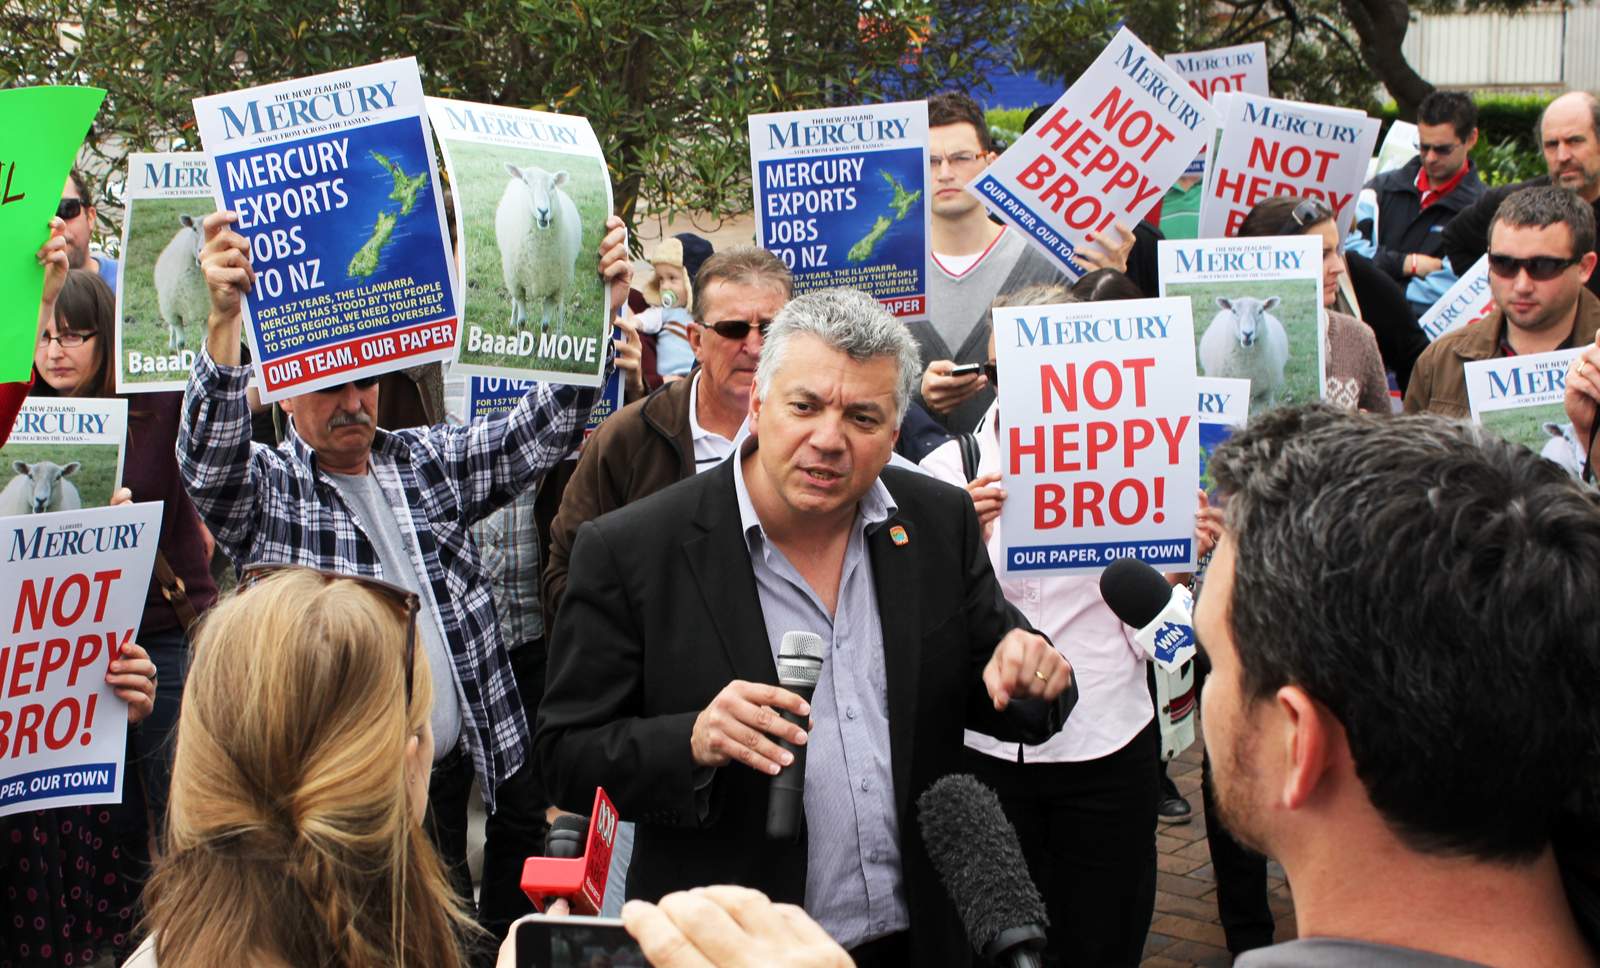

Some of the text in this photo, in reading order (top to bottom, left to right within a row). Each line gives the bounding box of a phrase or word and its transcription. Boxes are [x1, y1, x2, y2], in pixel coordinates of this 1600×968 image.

[1176, 52, 1256, 73] MERCURY
[275, 80, 352, 102] THE NEW ZEALAND
[1115, 44, 1205, 132] MERCURY
[217, 80, 398, 141] MERCURY
[444, 106, 580, 145] MERCURY
[843, 114, 874, 122] ZEALAND
[1090, 85, 1175, 163] NOT
[1242, 102, 1363, 144] MERCURY
[767, 117, 910, 150] MERCURY
[226, 138, 350, 192] MERCURY
[766, 157, 865, 189] MERCURY
[1035, 106, 1161, 214] HEPPY
[1247, 136, 1340, 183] NOT
[234, 178, 349, 229] EXPORTS
[768, 187, 857, 217] EXPORTS
[1015, 153, 1116, 243] BRO!
[768, 218, 819, 245] JOBS
[983, 180, 1084, 272] OUR PAPER, OUR TO
[802, 244, 829, 268] NZ
[805, 271, 833, 281] YEARS,
[834, 269, 850, 277] THE
[851, 264, 898, 276] ILLAWARRA
[1175, 248, 1305, 273] MERCURY
[254, 258, 325, 301] TO NZ
[811, 279, 829, 287] HAS
[830, 275, 857, 285] STOOD
[859, 274, 870, 282] BY
[871, 272, 886, 280] THE
[887, 268, 918, 279] PEOPLE
[875, 278, 897, 288] YOUR
[898, 276, 919, 285] HELP
[875, 284, 919, 296] OVERSEAS.
[257, 276, 415, 320] FOR 157 YEARS, THE ILLAWARRA
[260, 281, 442, 332] MERCURY HAS STOOD BY THE PEOPLE
[263, 292, 444, 342] OF THIS REGION. WE NEED YOUR HELP
[265, 304, 446, 353] TO STOP OUR JOBS GOING OVERSEAS.
[467, 325, 597, 363] BaaaD MOVE
[1014, 314, 1173, 348] MERCURY
[127, 349, 196, 375] BaaaD
[268, 324, 454, 385] OUR TEAM, OUR PAPER
[1550, 359, 1569, 369] NEW
[1040, 357, 1156, 414] NOT
[1487, 367, 1569, 399] MER
[475, 399, 492, 407] FOR
[493, 398, 507, 406] 157
[1009, 415, 1192, 475] HEPPY
[1033, 476, 1166, 530] BRO!
[7, 522, 145, 563] MERCURY
[1013, 543, 1185, 565] OUR PAPER, OUR TOWN
[12, 569, 122, 634] NOT
[1156, 625, 1184, 650] WIN
[30, 775, 60, 793] OUR
[63, 770, 109, 788] TOWN
